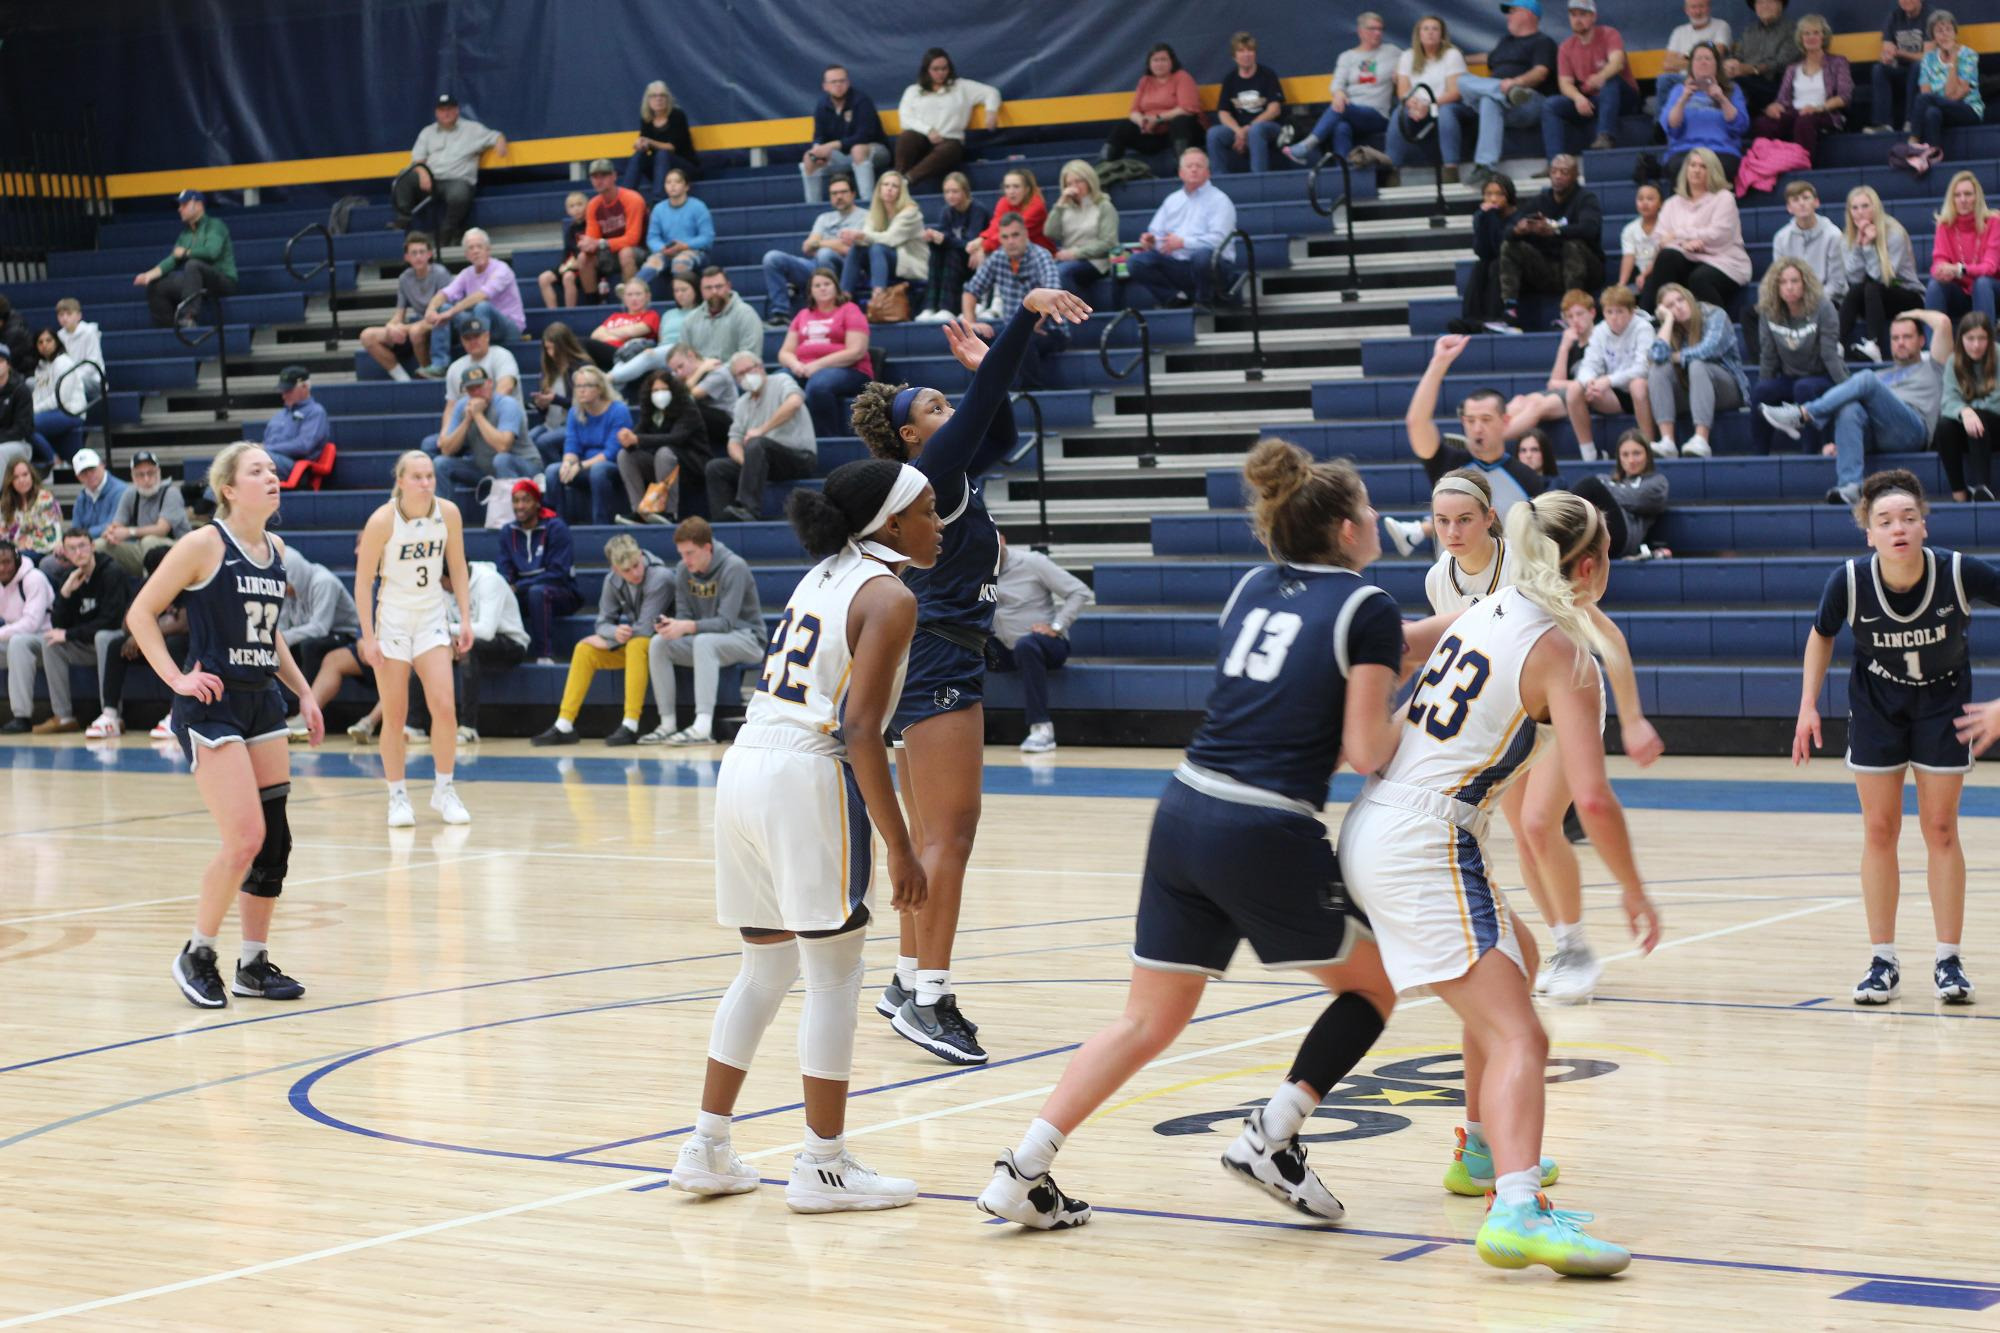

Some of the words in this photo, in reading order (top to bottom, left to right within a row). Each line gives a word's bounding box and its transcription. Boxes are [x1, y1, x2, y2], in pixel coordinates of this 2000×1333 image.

[399, 539, 443, 561] E&H
[415, 566, 429, 588] 3
[1222, 607, 1304, 683] 13
[1872, 623, 1947, 649] LINCOLN
[754, 604, 822, 707] 22
[1903, 650, 1924, 681] 1
[1405, 632, 1492, 744] 23
